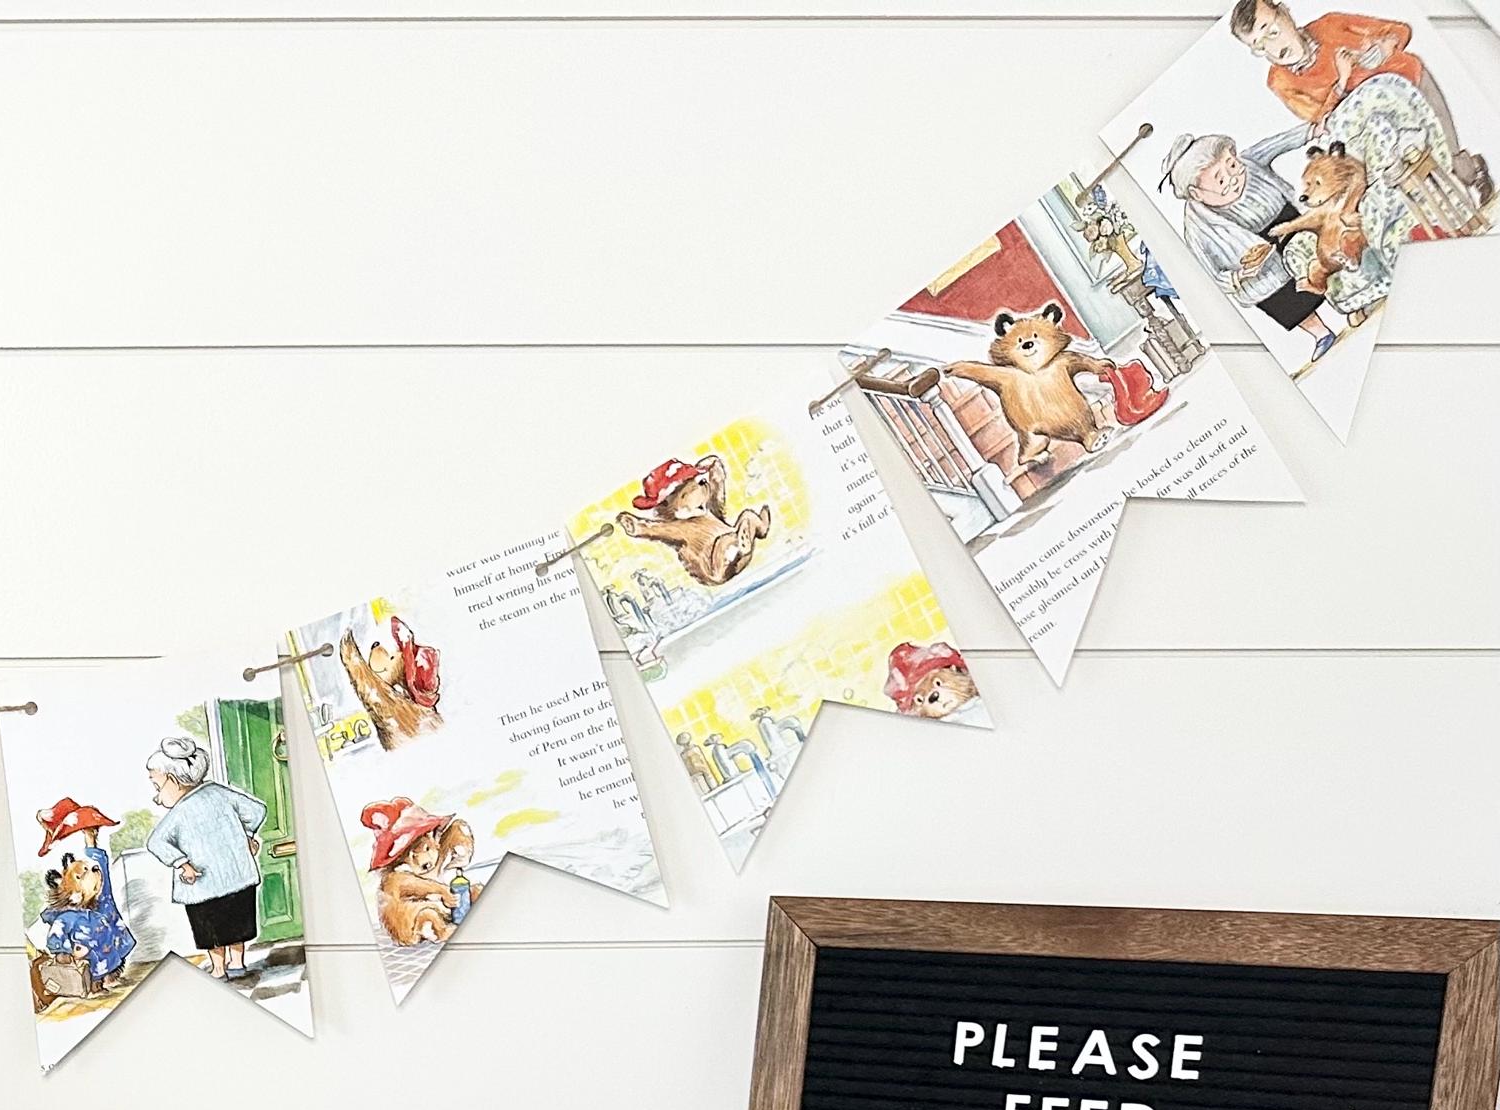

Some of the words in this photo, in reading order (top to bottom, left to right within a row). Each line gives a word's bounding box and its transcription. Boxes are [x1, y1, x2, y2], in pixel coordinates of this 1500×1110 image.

[822, 420, 843, 436] that
[831, 435, 856, 453] bath
[848, 494, 876, 514] again
[1039, 540, 1065, 563] came
[1067, 500, 1123, 542] downstairs,
[1136, 458, 1172, 489] looked
[1173, 452, 1184, 462] so
[1185, 430, 1213, 453] clean
[1213, 418, 1228, 432] no
[859, 513, 876, 531] full
[877, 504, 888, 519] of
[1008, 577, 1049, 612] possibly
[1047, 567, 1062, 579] be
[1064, 549, 1088, 569] cross
[1088, 530, 1112, 549] with
[1156, 483, 1172, 498] fur
[1173, 470, 1194, 486] was
[1194, 455, 1208, 471] all
[1209, 440, 1227, 459] soft
[1228, 425, 1248, 445] and
[1038, 576, 1079, 614] gleamed
[1081, 560, 1100, 581] and
[1198, 468, 1228, 491] traces
[1229, 455, 1240, 469] of
[1240, 444, 1257, 460] the
[453, 572, 493, 597] himself
[494, 571, 506, 582] at
[467, 595, 493, 613] tried
[495, 583, 534, 602] writing
[536, 577, 551, 588] his
[479, 619, 496, 631] the
[498, 606, 530, 624] steam
[533, 600, 547, 610] on
[549, 591, 566, 604] the
[498, 711, 527, 727] Then
[529, 704, 543, 716] he
[546, 692, 570, 709] used
[572, 687, 589, 700] Mr
[508, 722, 551, 743] shaving
[552, 711, 580, 728] foam
[583, 706, 594, 716] to
[528, 745, 540, 758] of
[542, 737, 567, 752] Peru
[570, 731, 585, 742] on
[587, 724, 604, 736] the
[557, 757, 567, 767] It
[558, 766, 595, 788] landed
[598, 761, 612, 773] on
[578, 790, 592, 801] he
[612, 799, 627, 809] he
[953, 1021, 1203, 1080] PLEASE
